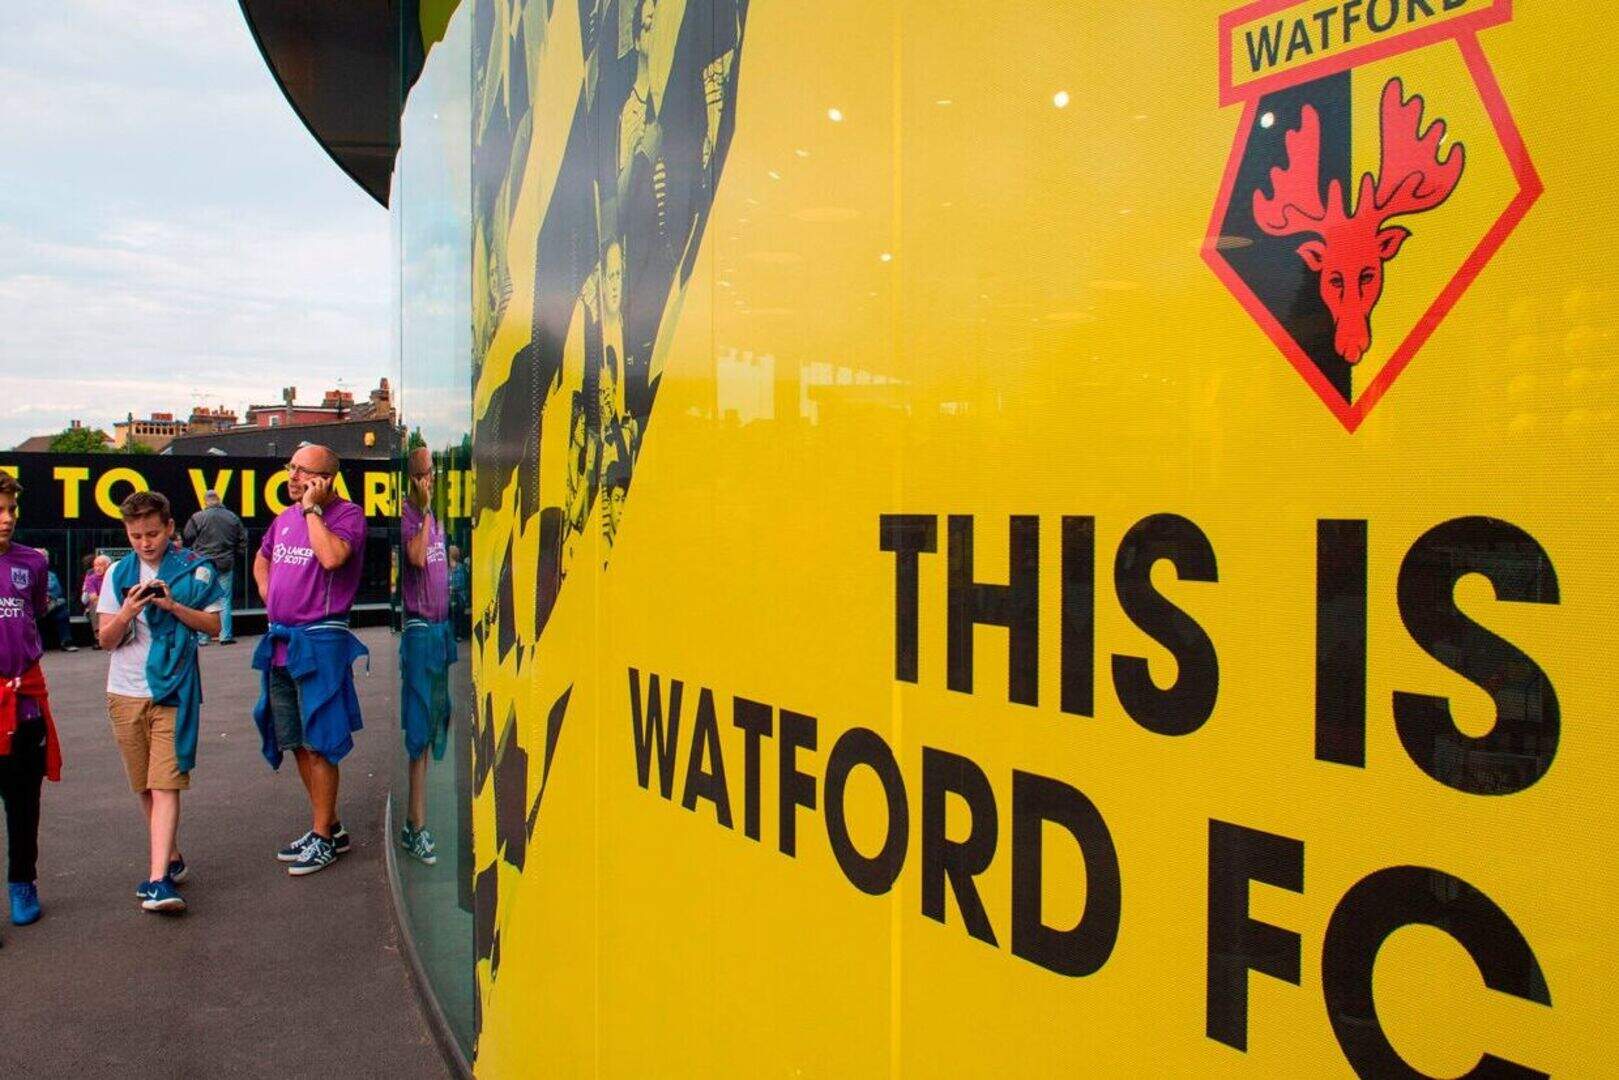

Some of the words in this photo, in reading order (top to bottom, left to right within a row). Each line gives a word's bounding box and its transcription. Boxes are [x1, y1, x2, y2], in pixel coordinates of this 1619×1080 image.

[1245, 0, 1468, 72] WATFOR
[53, 466, 149, 519] TO
[880, 513, 1219, 737] THIS
[1315, 515, 1560, 796] IS
[629, 668, 1121, 977] WATFORD
[1207, 819, 1553, 1080] FC
